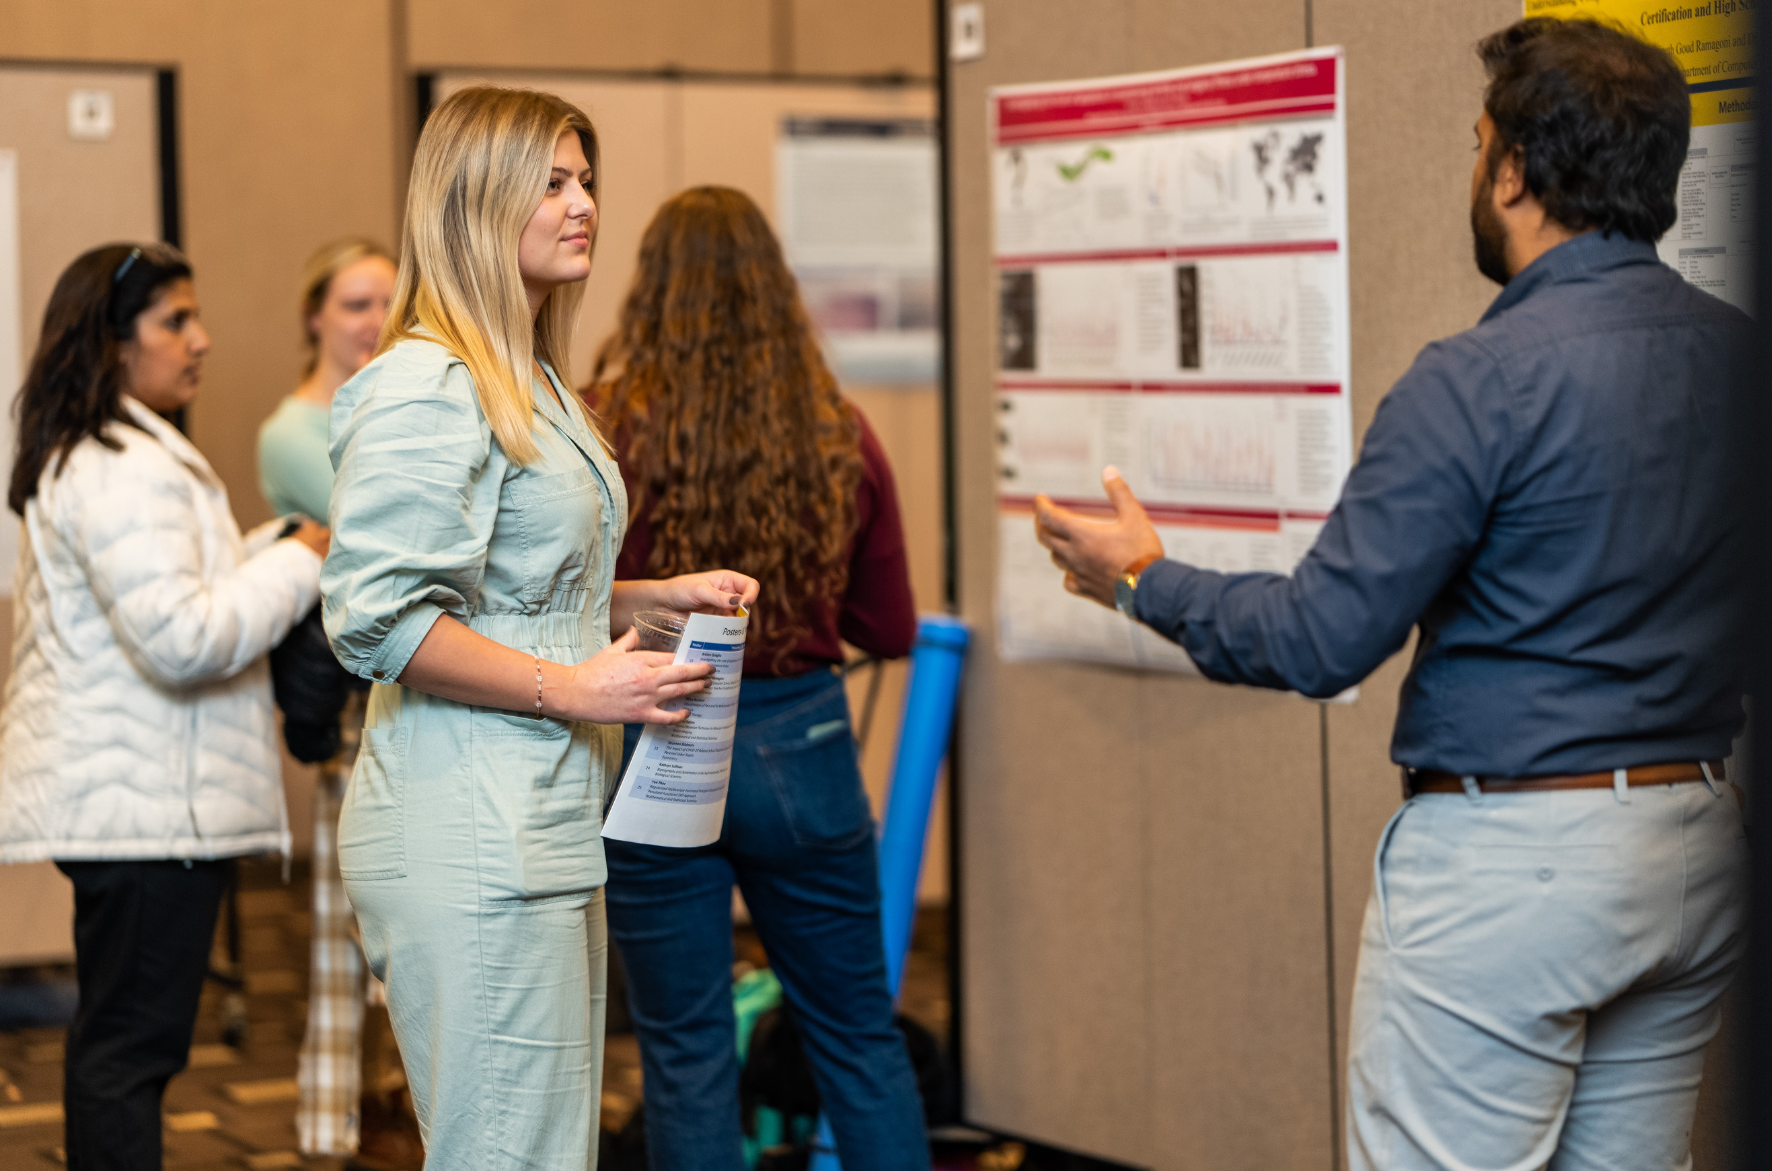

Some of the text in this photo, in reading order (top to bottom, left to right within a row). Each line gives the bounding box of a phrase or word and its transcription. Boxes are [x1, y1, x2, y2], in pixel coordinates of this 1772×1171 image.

[1641, 6, 1692, 25] Certification
[1695, 2, 1711, 17] and
[1714, 0, 1736, 17] High
[1676, 41, 1694, 55] Goud
[1696, 36, 1731, 52] Ramagoni
[1733, 33, 1745, 46] and
[1713, 61, 1721, 74] of
[722, 627, 741, 636] Posters
